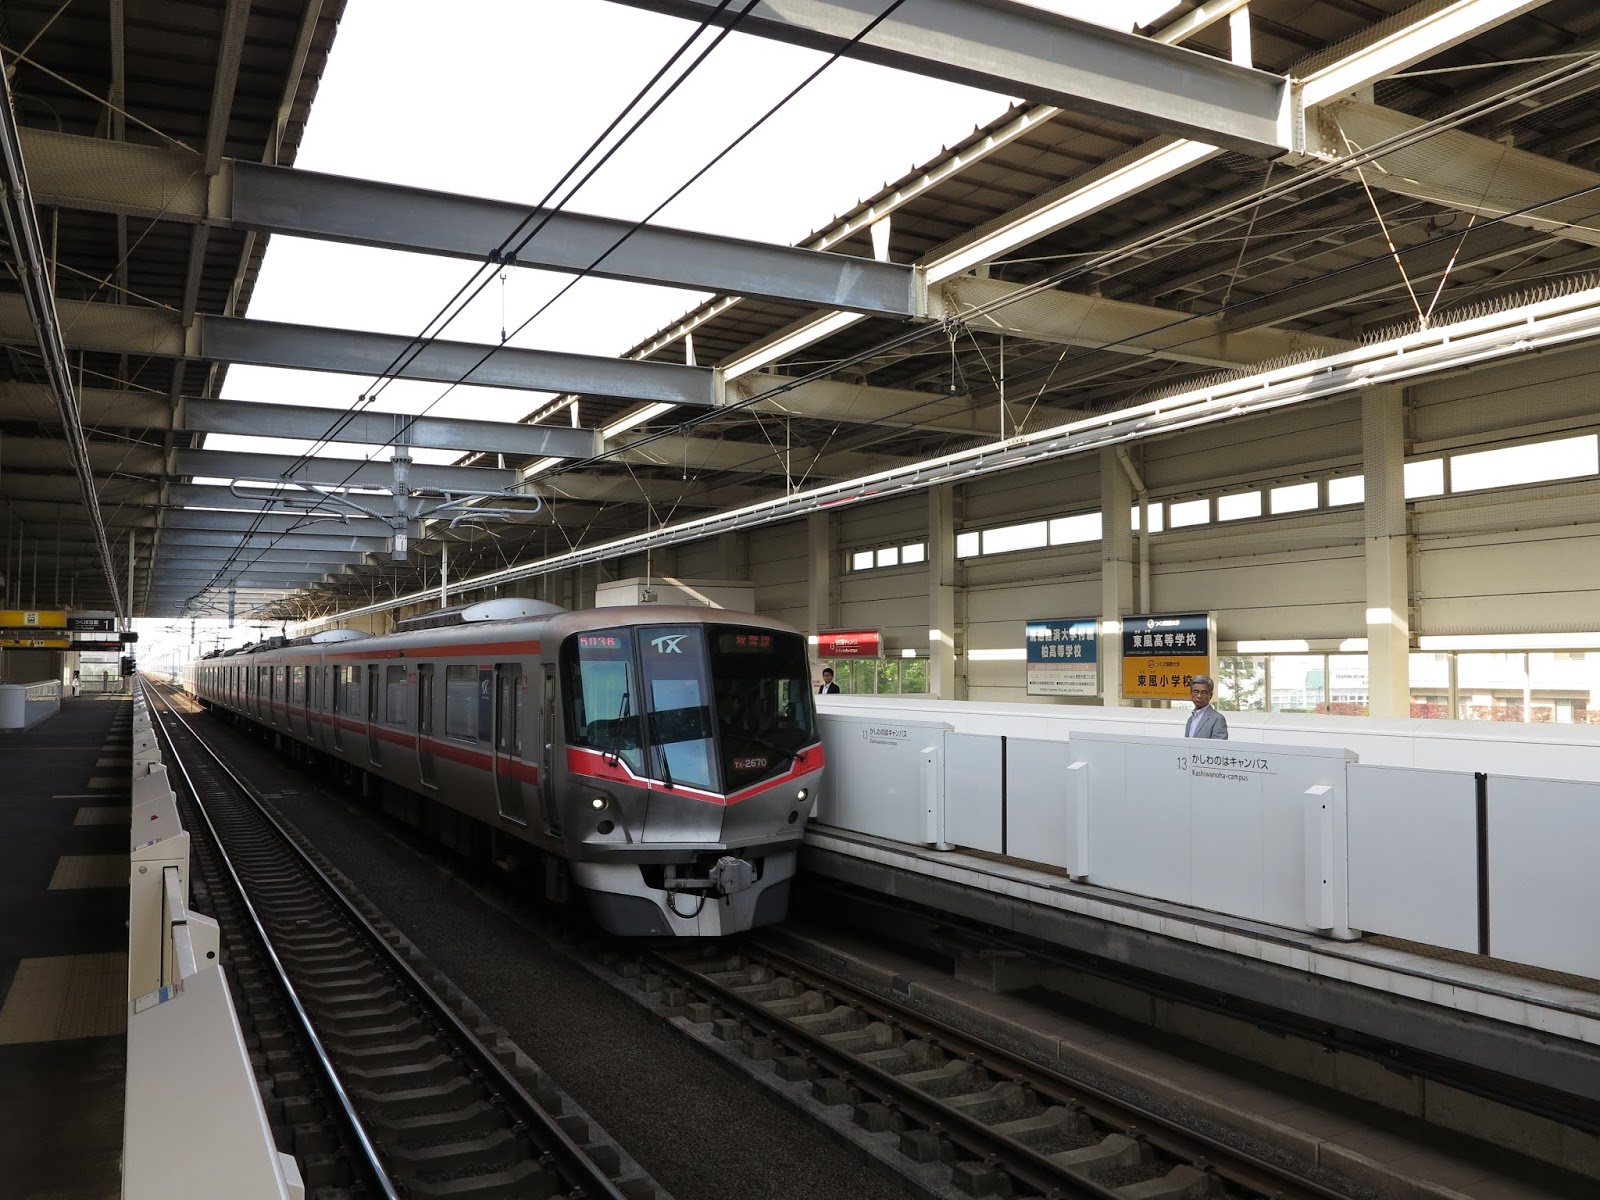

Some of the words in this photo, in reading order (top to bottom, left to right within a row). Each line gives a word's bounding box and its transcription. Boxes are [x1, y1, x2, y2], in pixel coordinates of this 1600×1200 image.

[104, 620, 109, 630] 1
[579, 636, 615, 647] 5036
[651, 634, 689, 654] TX
[1133, 633, 1197, 648] 東風高等学校
[1041, 644, 1082, 658] 柏高等学校
[1137, 675, 1192, 687] 東風小学校
[862, 730, 868, 740] 13
[735, 758, 767, 768] TX-2670
[1177, 757, 1188, 771] 13
[1192, 754, 1269, 770] かしわのはキャンパス
[1192, 769, 1248, 782] Kashiwanoha-campus
